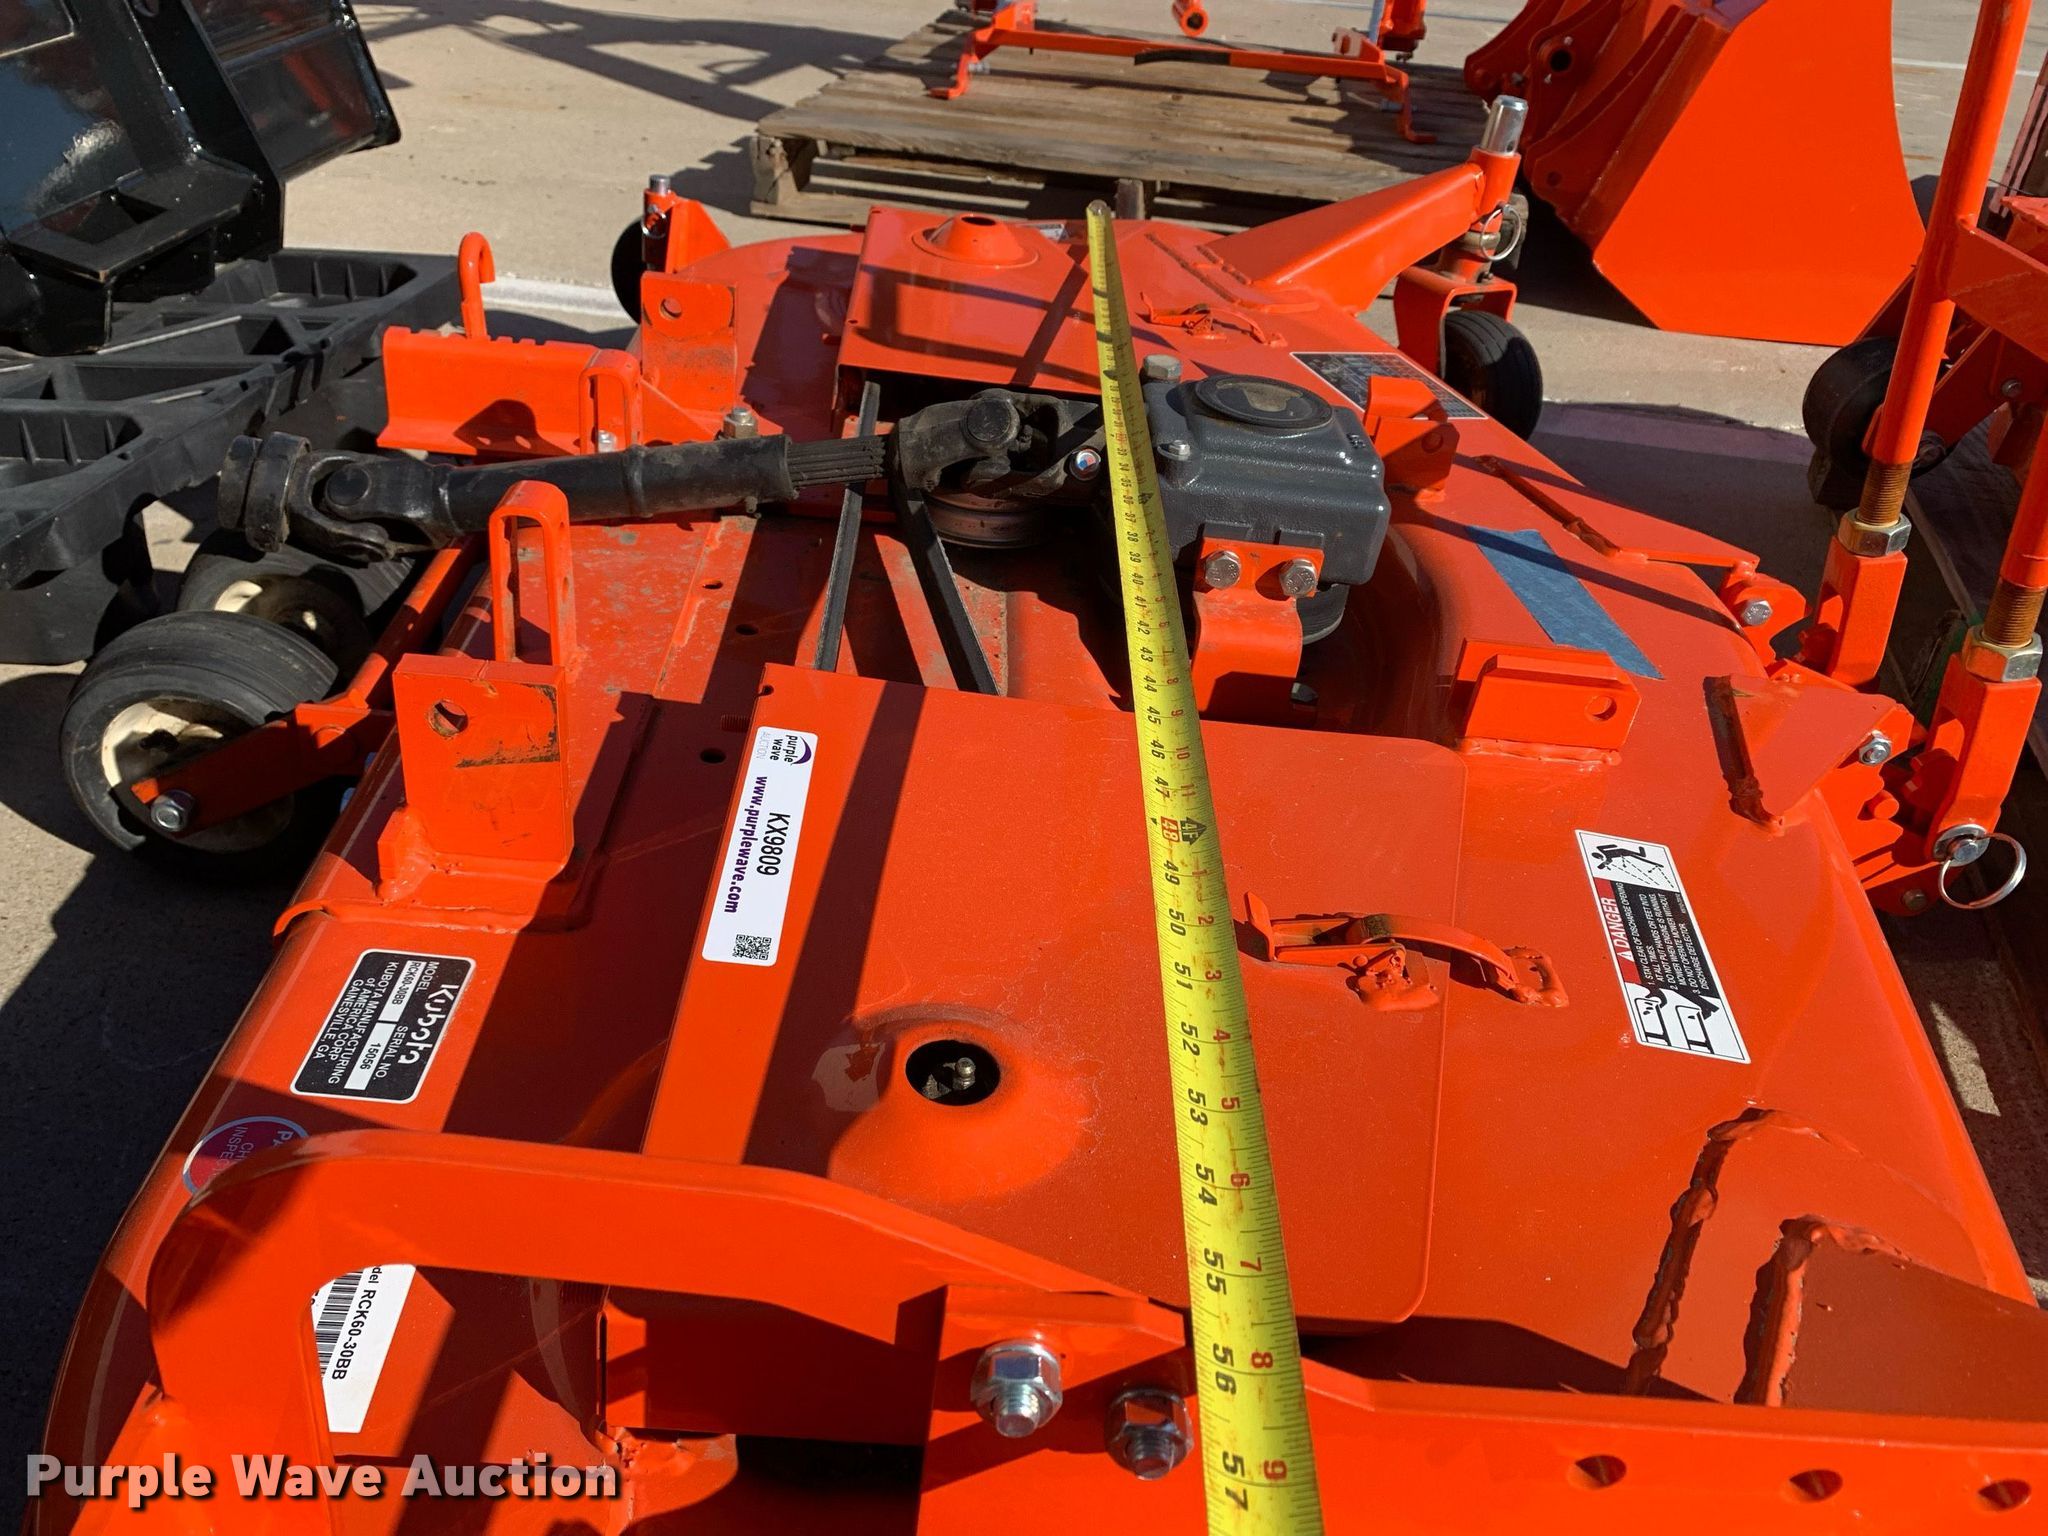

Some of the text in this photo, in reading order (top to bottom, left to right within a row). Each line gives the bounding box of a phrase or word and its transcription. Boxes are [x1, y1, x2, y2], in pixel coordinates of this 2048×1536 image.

[1125, 512, 1137, 524] 37
[1127, 531, 1139, 543] 38
[1129, 551, 1142, 564] 39
[1131, 572, 1144, 586] 40
[1134, 595, 1147, 609] 41
[1137, 620, 1151, 636] 42
[1140, 646, 1154, 663] 43
[1143, 675, 1157, 693] 44
[1146, 705, 1161, 725] 45
[1171, 708, 1184, 718] 9
[770, 738, 783, 761] wave
[784, 734, 798, 763] purple
[1150, 739, 1165, 760] 46
[1175, 745, 1191, 760] 10
[1154, 776, 1170, 799] 47
[1180, 783, 1196, 798] 11
[1161, 819, 1179, 842] 48
[724, 776, 767, 913] www.purplewave.com
[756, 811, 791, 876] KX9809
[1163, 859, 1180, 886] 49
[1168, 907, 1186, 937] 50
[1198, 915, 1215, 926] 2
[1599, 896, 1630, 948] DANGER
[365, 977, 376, 988] of
[415, 961, 440, 993] MODEL
[1174, 961, 1193, 990] 51
[1205, 969, 1222, 981] 3
[341, 988, 372, 1030] AMERICA
[328, 961, 399, 1084] KUBOTA MANUFACTURING
[398, 984, 459, 1064] Kubota
[387, 1025, 409, 1061] SERIAL
[1180, 1020, 1201, 1056] 52
[1212, 1027, 1231, 1043] 4
[312, 1044, 330, 1059] GA
[360, 1042, 382, 1070] 15056
[1187, 1087, 1208, 1127] 53
[1220, 1096, 1240, 1111] 5
[1195, 1163, 1218, 1207] 54
[1230, 1172, 1250, 1188] 6
[1203, 1247, 1227, 1296] 55
[1240, 1256, 1263, 1273] 7
[332, 1289, 376, 1380] RCK60-30BB
[1212, 1342, 1237, 1396] 56
[1250, 1350, 1274, 1370] 8
[1222, 1450, 1249, 1512] 57
[1263, 1458, 1288, 1481] 9
